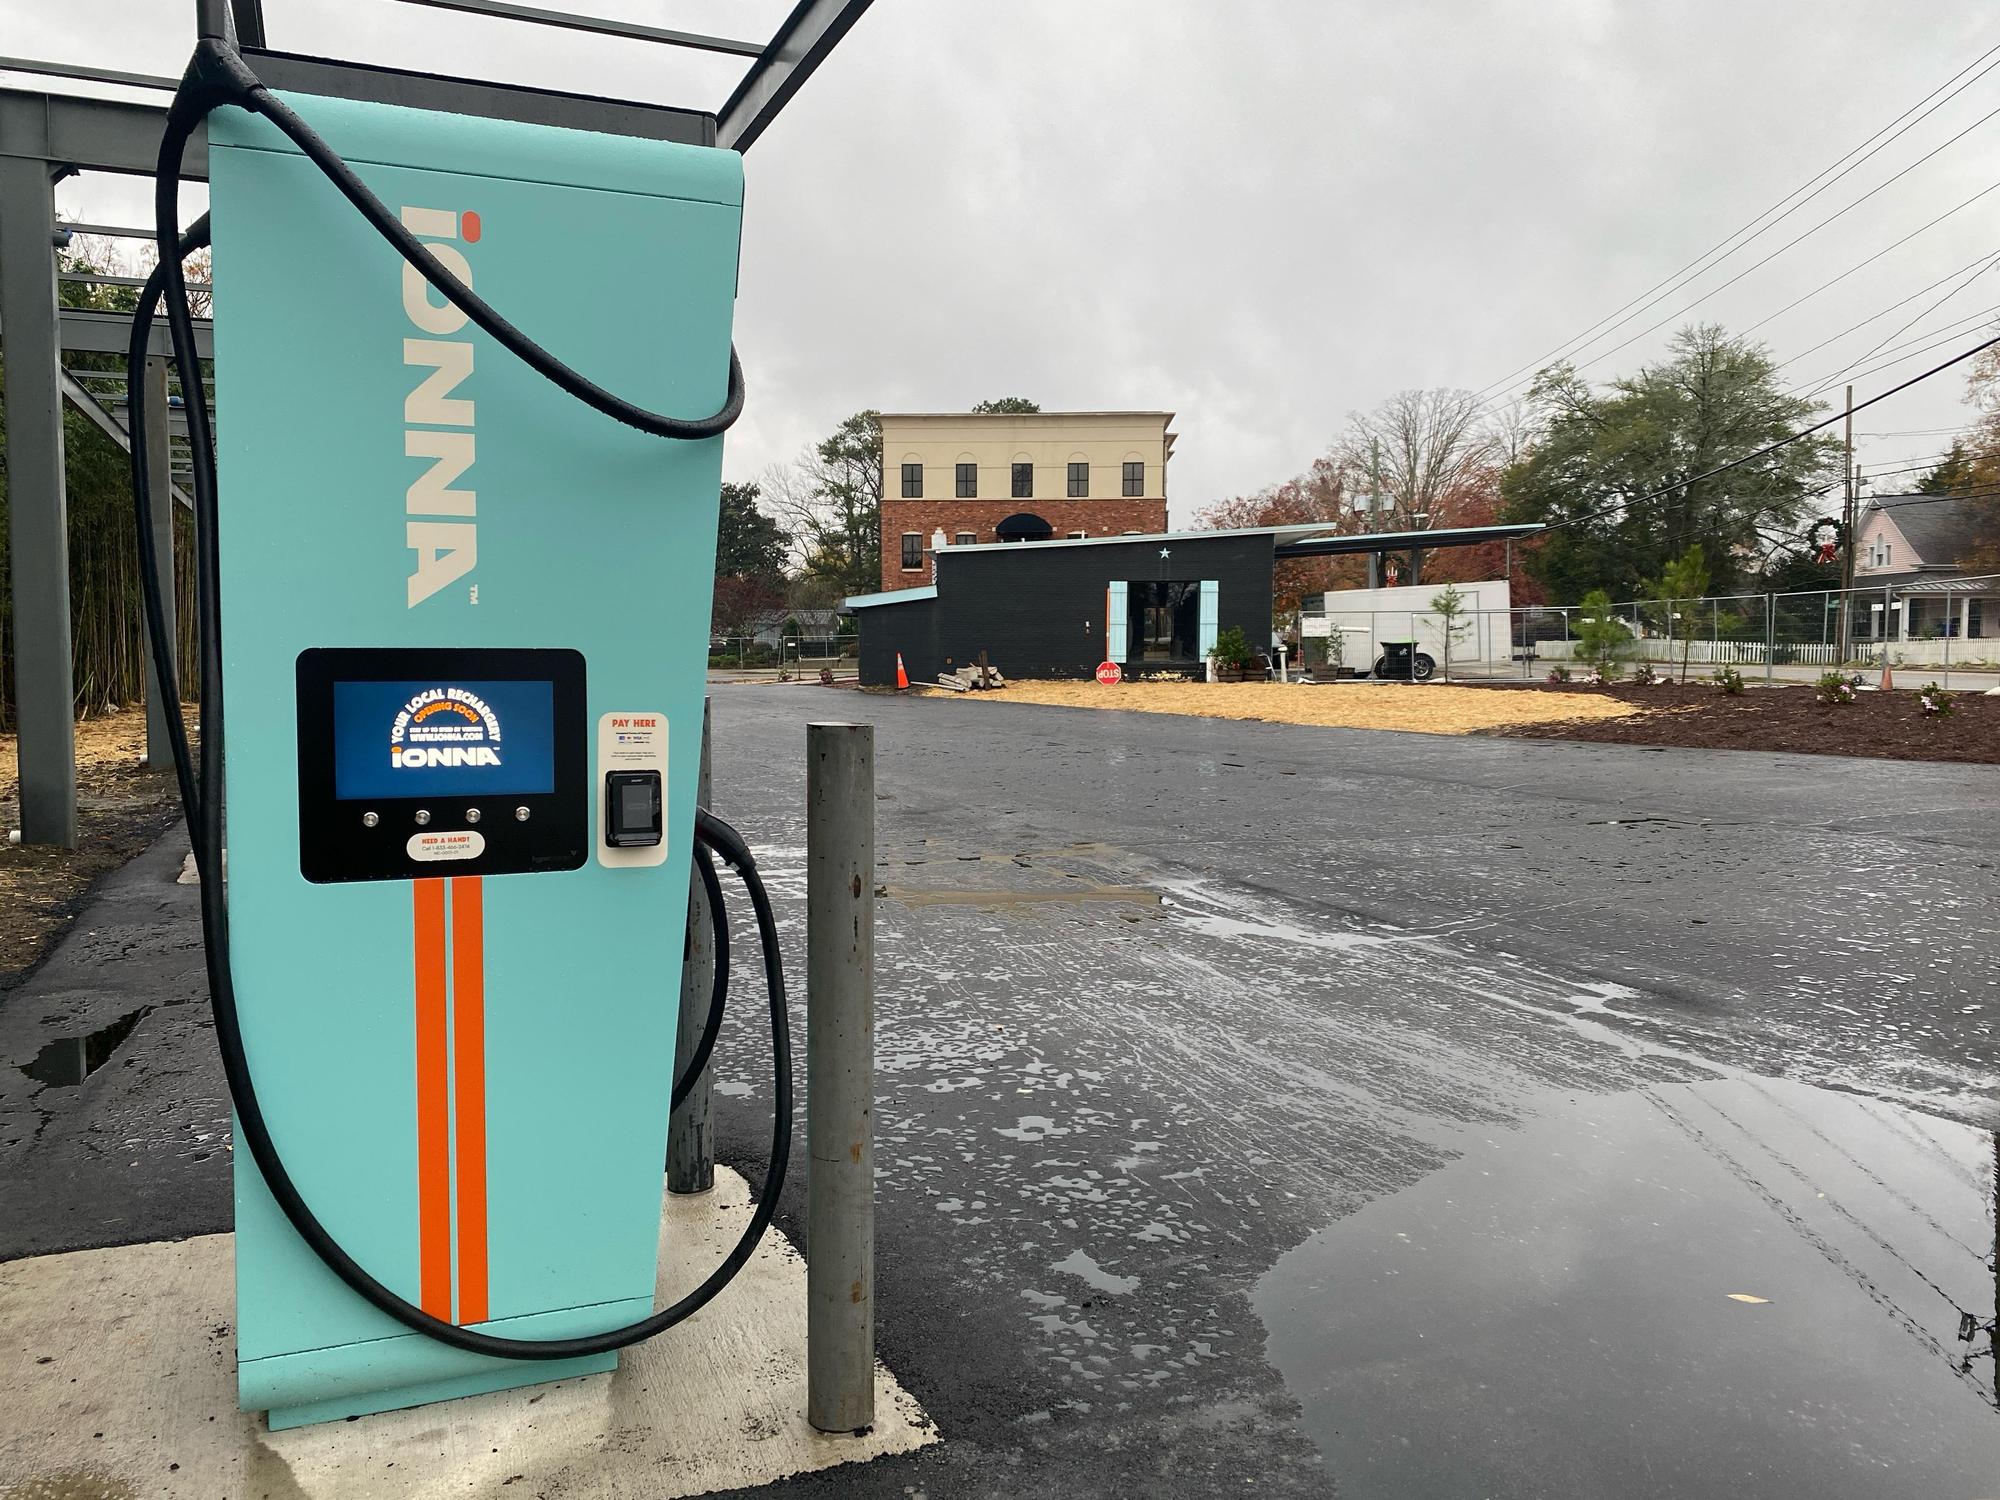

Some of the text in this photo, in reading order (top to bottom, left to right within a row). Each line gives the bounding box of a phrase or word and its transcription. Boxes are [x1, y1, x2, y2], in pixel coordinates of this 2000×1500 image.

[1098, 669, 1119, 678] STOP
[391, 688, 501, 744] YOUR LOCAL RECHARGERY
[413, 702, 480, 723] OPENING SOON
[612, 719, 656, 727] PAY HERE
